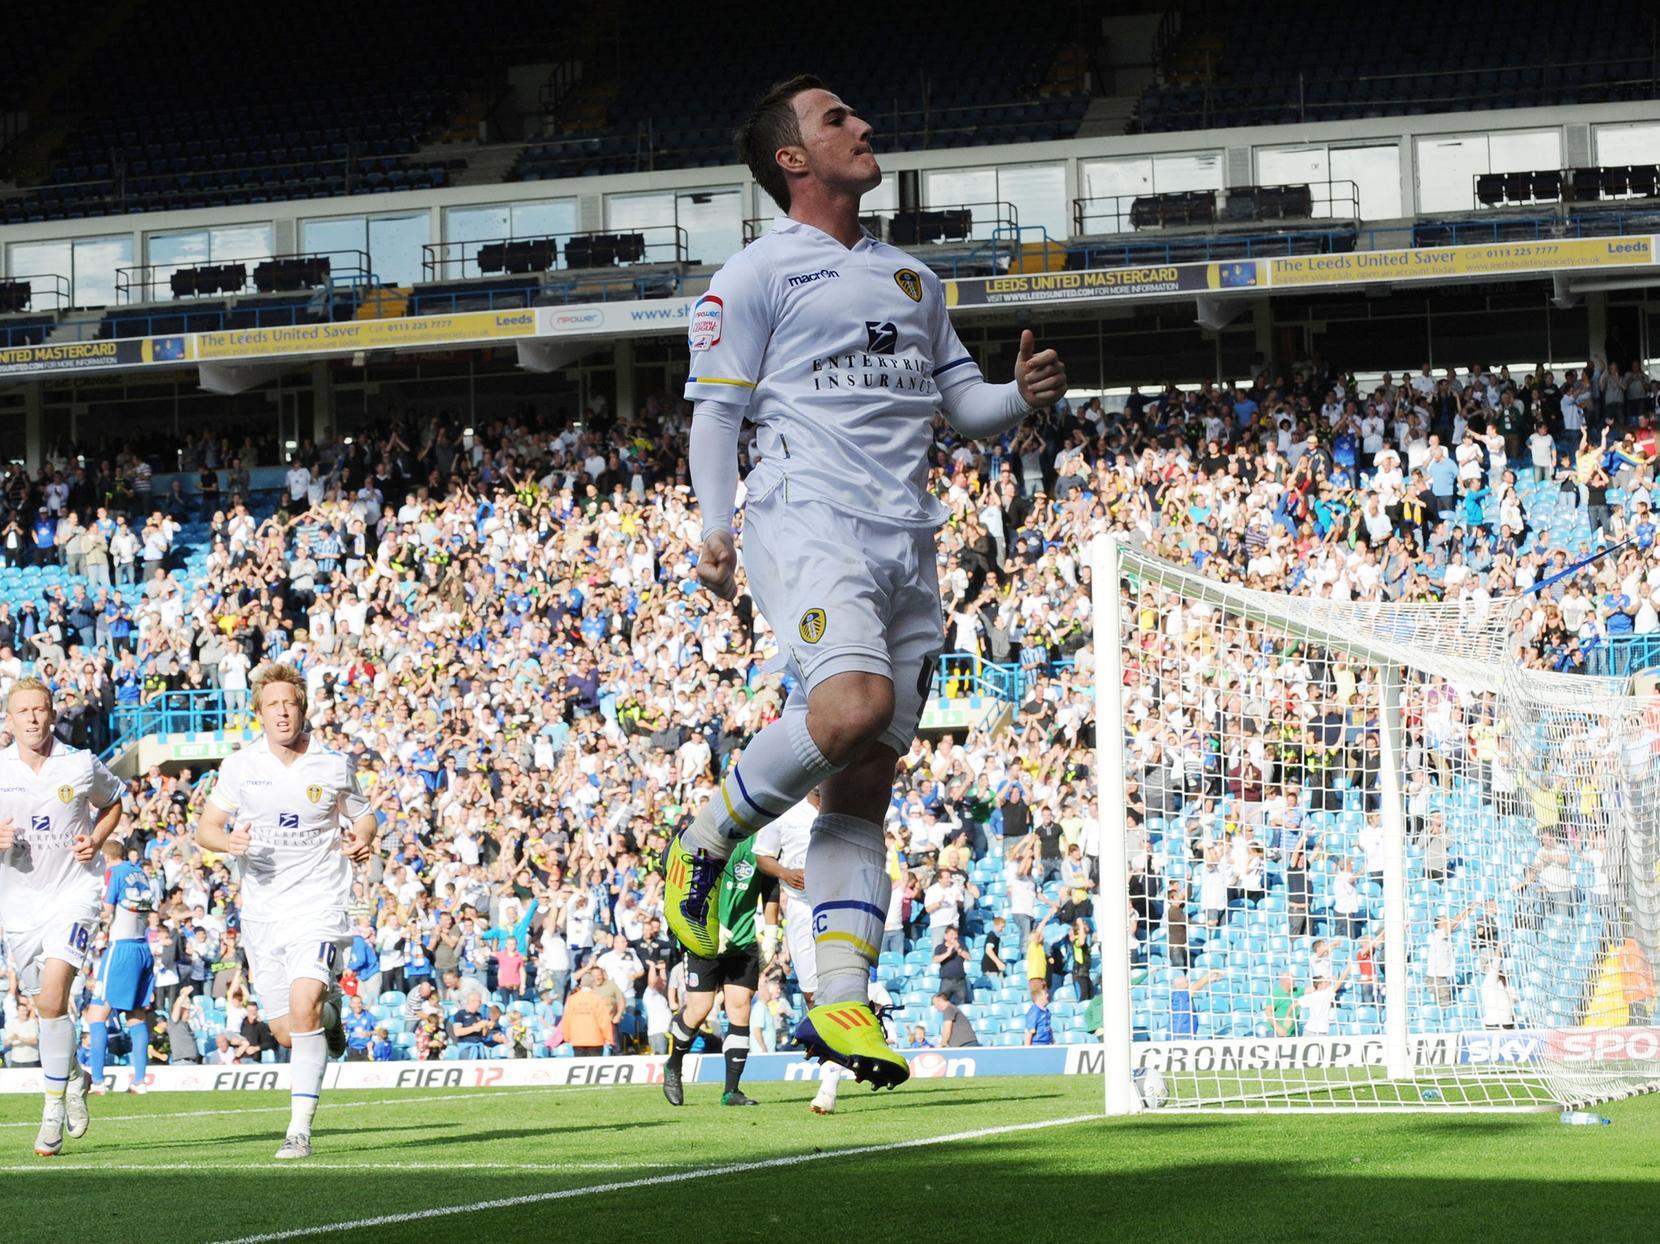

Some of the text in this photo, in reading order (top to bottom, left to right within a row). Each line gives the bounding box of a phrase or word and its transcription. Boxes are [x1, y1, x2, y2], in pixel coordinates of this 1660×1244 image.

[1487, 249, 1511, 258] 0113
[1514, 248, 1531, 256] 225
[1535, 246, 1560, 255] 7777
[1608, 241, 1649, 253] Leeds
[1274, 251, 1457, 272] The Leeds United Saver
[788, 269, 840, 287] macron
[985, 268, 1179, 293] LEEDS UNITED MASTERCARD
[1095, 286, 1109, 295] FOR
[1110, 285, 1130, 294] MORE
[1131, 282, 1179, 293] INFORMATION
[495, 314, 533, 326] Leeds
[557, 313, 598, 324] npower
[201, 334, 225, 346] The
[230, 331, 268, 345] Leeds
[272, 327, 319, 342] United
[323, 325, 361, 339] Saver
[35, 343, 117, 360] MASTERCARD
[812, 355, 931, 378] ENTERPRI
[69, 921, 89, 953] 18
[1076, 1038, 1447, 1075] MCRONSHOP.CM
[1468, 1032, 1539, 1062] sky
[214, 1071, 279, 1090] FIFA
[396, 1068, 463, 1087] FIFA
[474, 1067, 504, 1088] 12
[565, 1064, 634, 1084] FIFA
